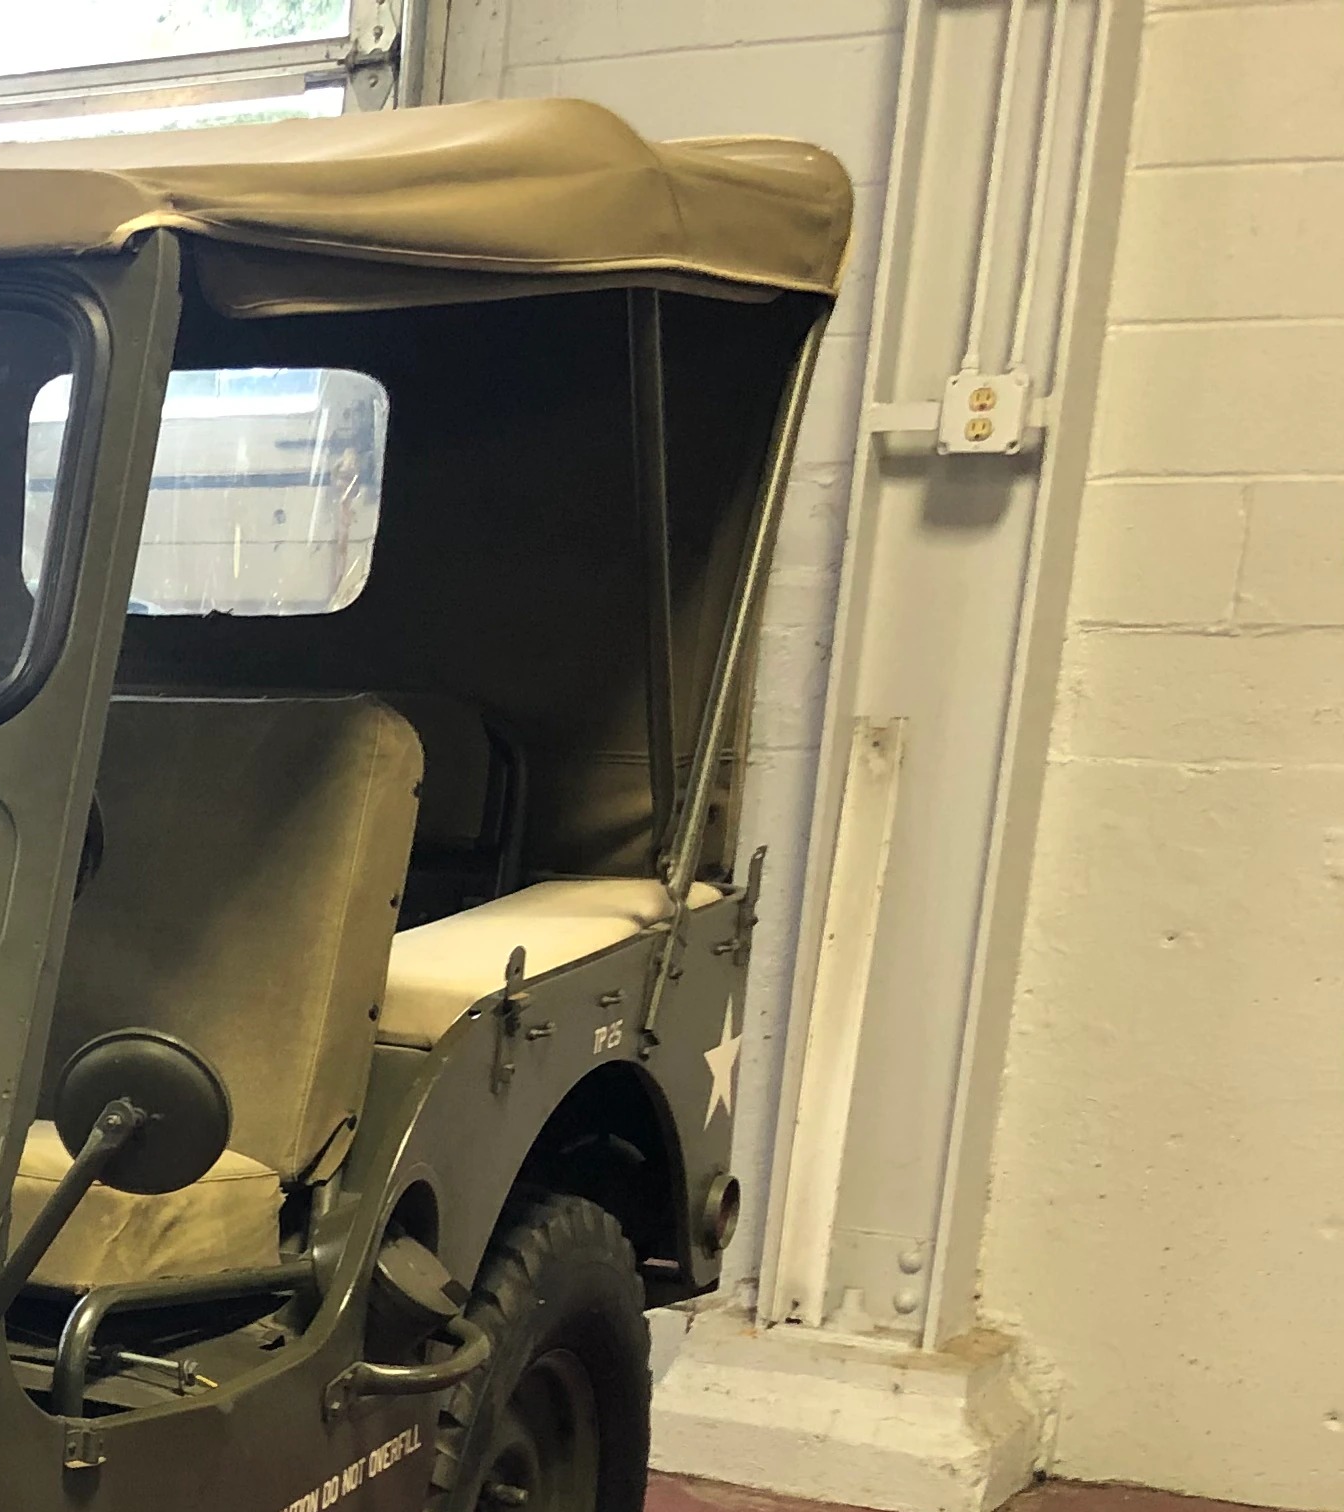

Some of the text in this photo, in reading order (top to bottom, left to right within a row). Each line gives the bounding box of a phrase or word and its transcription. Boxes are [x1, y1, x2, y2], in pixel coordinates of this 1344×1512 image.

[322, 1475, 340, 1510] DO
[341, 1457, 366, 1496] NOT
[368, 1424, 422, 1478] OVERFILL
